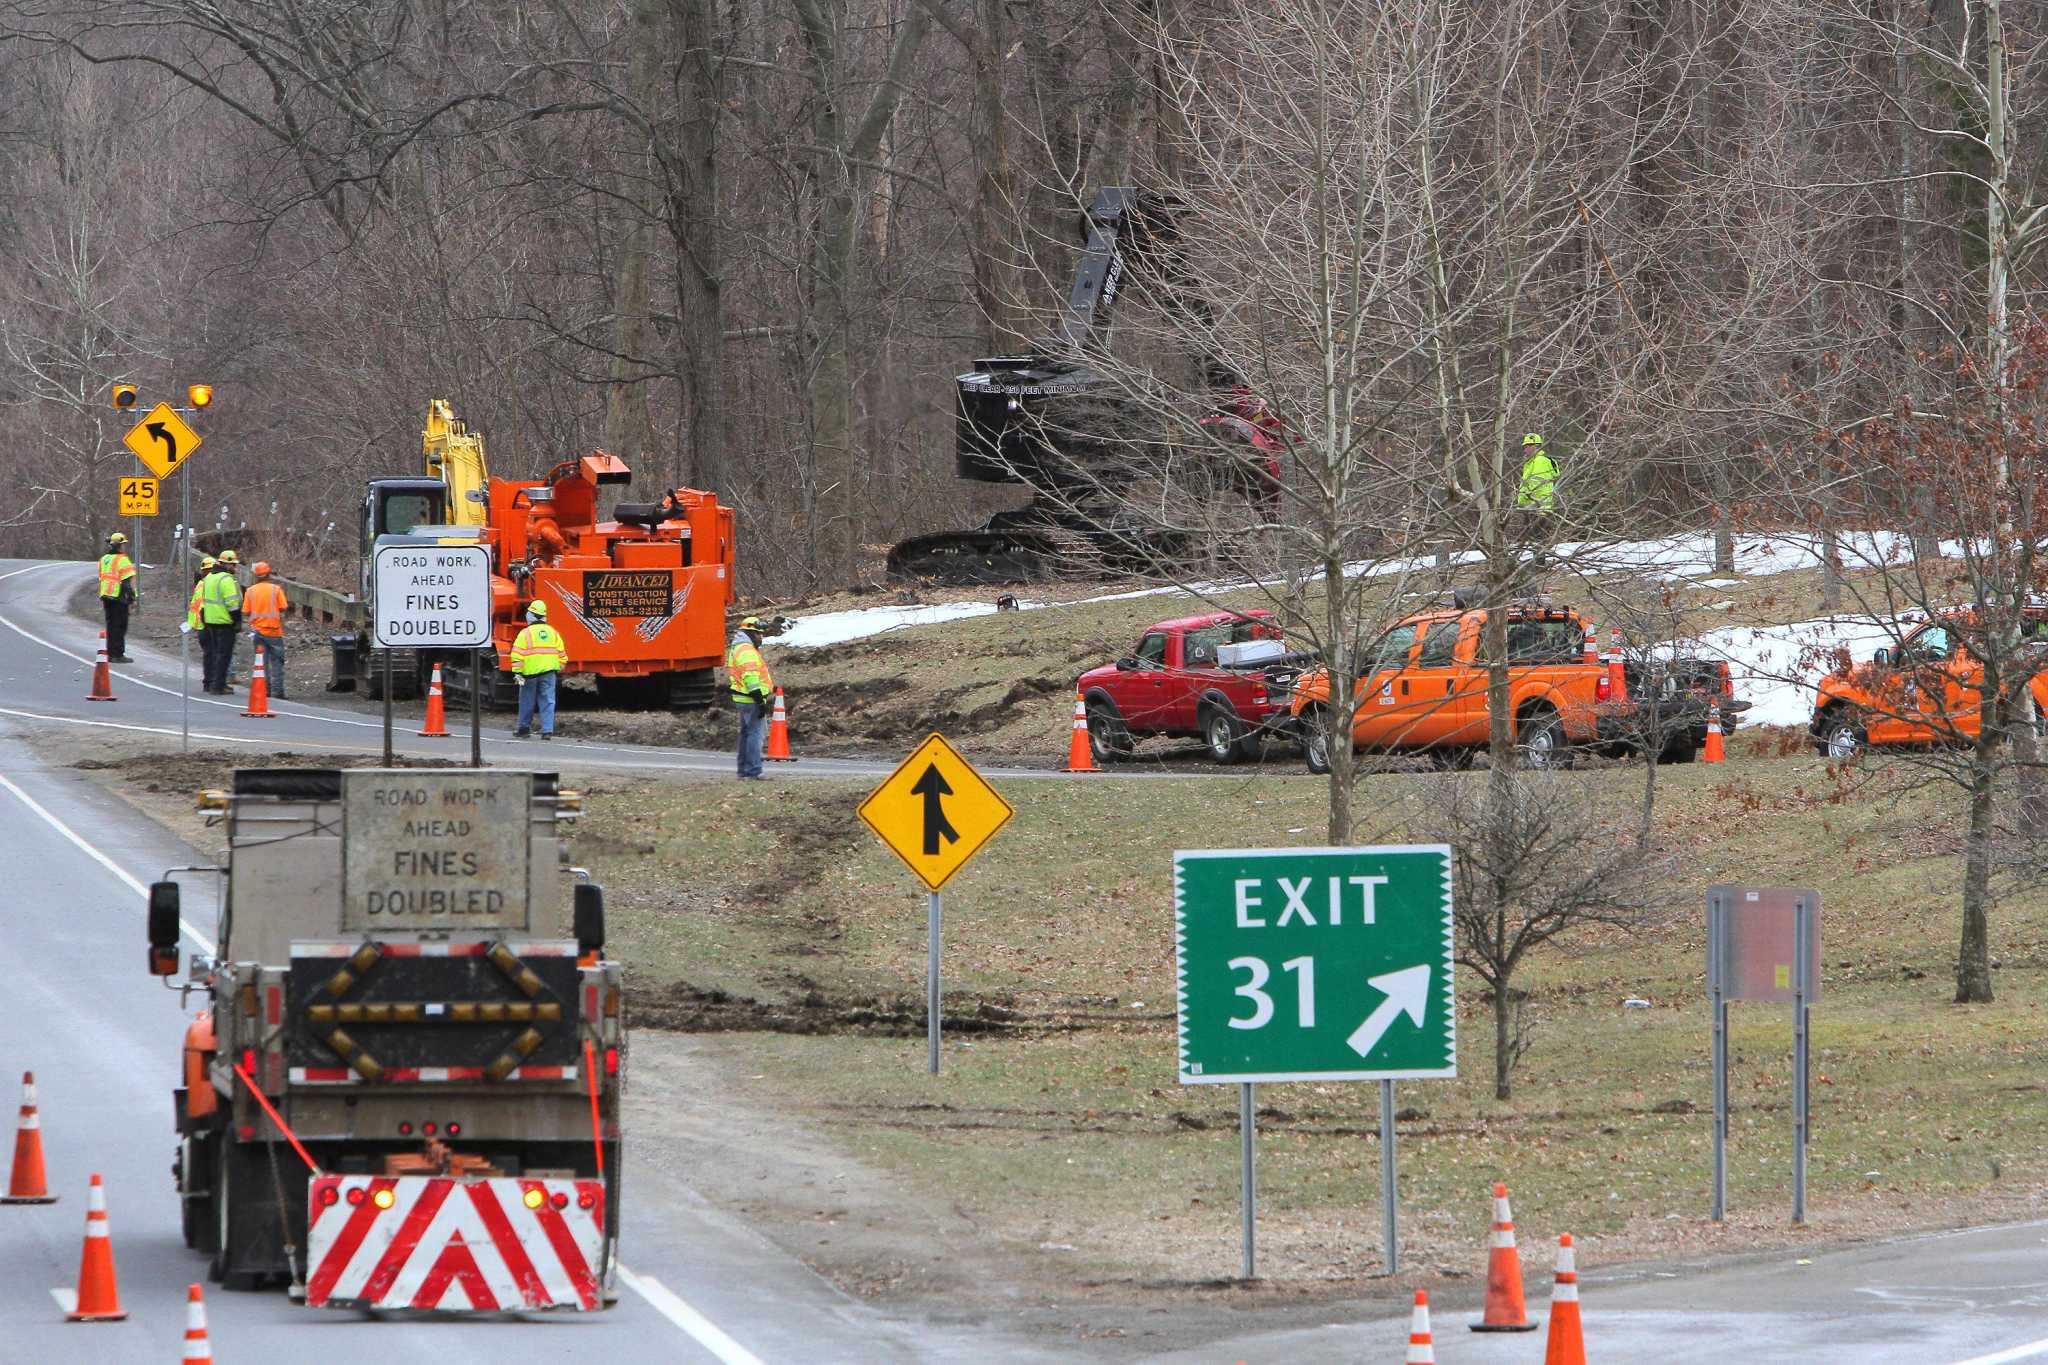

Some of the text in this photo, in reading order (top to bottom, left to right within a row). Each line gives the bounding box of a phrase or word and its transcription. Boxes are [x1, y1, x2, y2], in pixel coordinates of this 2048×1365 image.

[122, 482, 154, 498] 45
[393, 556, 472, 567] ROAD WORK
[410, 575, 454, 586] AHEAD
[587, 574, 669, 589] ADVANCED
[588, 590, 668, 598] CONSTRUCTION
[600, 598, 624, 606] TREE
[626, 598, 668, 606] SERVICE
[406, 595, 459, 610] FINES
[390, 620, 476, 636] DOUBLED
[374, 789, 427, 806] ROAD
[402, 820, 471, 838] AHEAD
[394, 851, 478, 877] FINES
[368, 890, 504, 916] DOUBLED
[1234, 875, 1389, 929] EXIT
[1226, 955, 1316, 1031] 31
